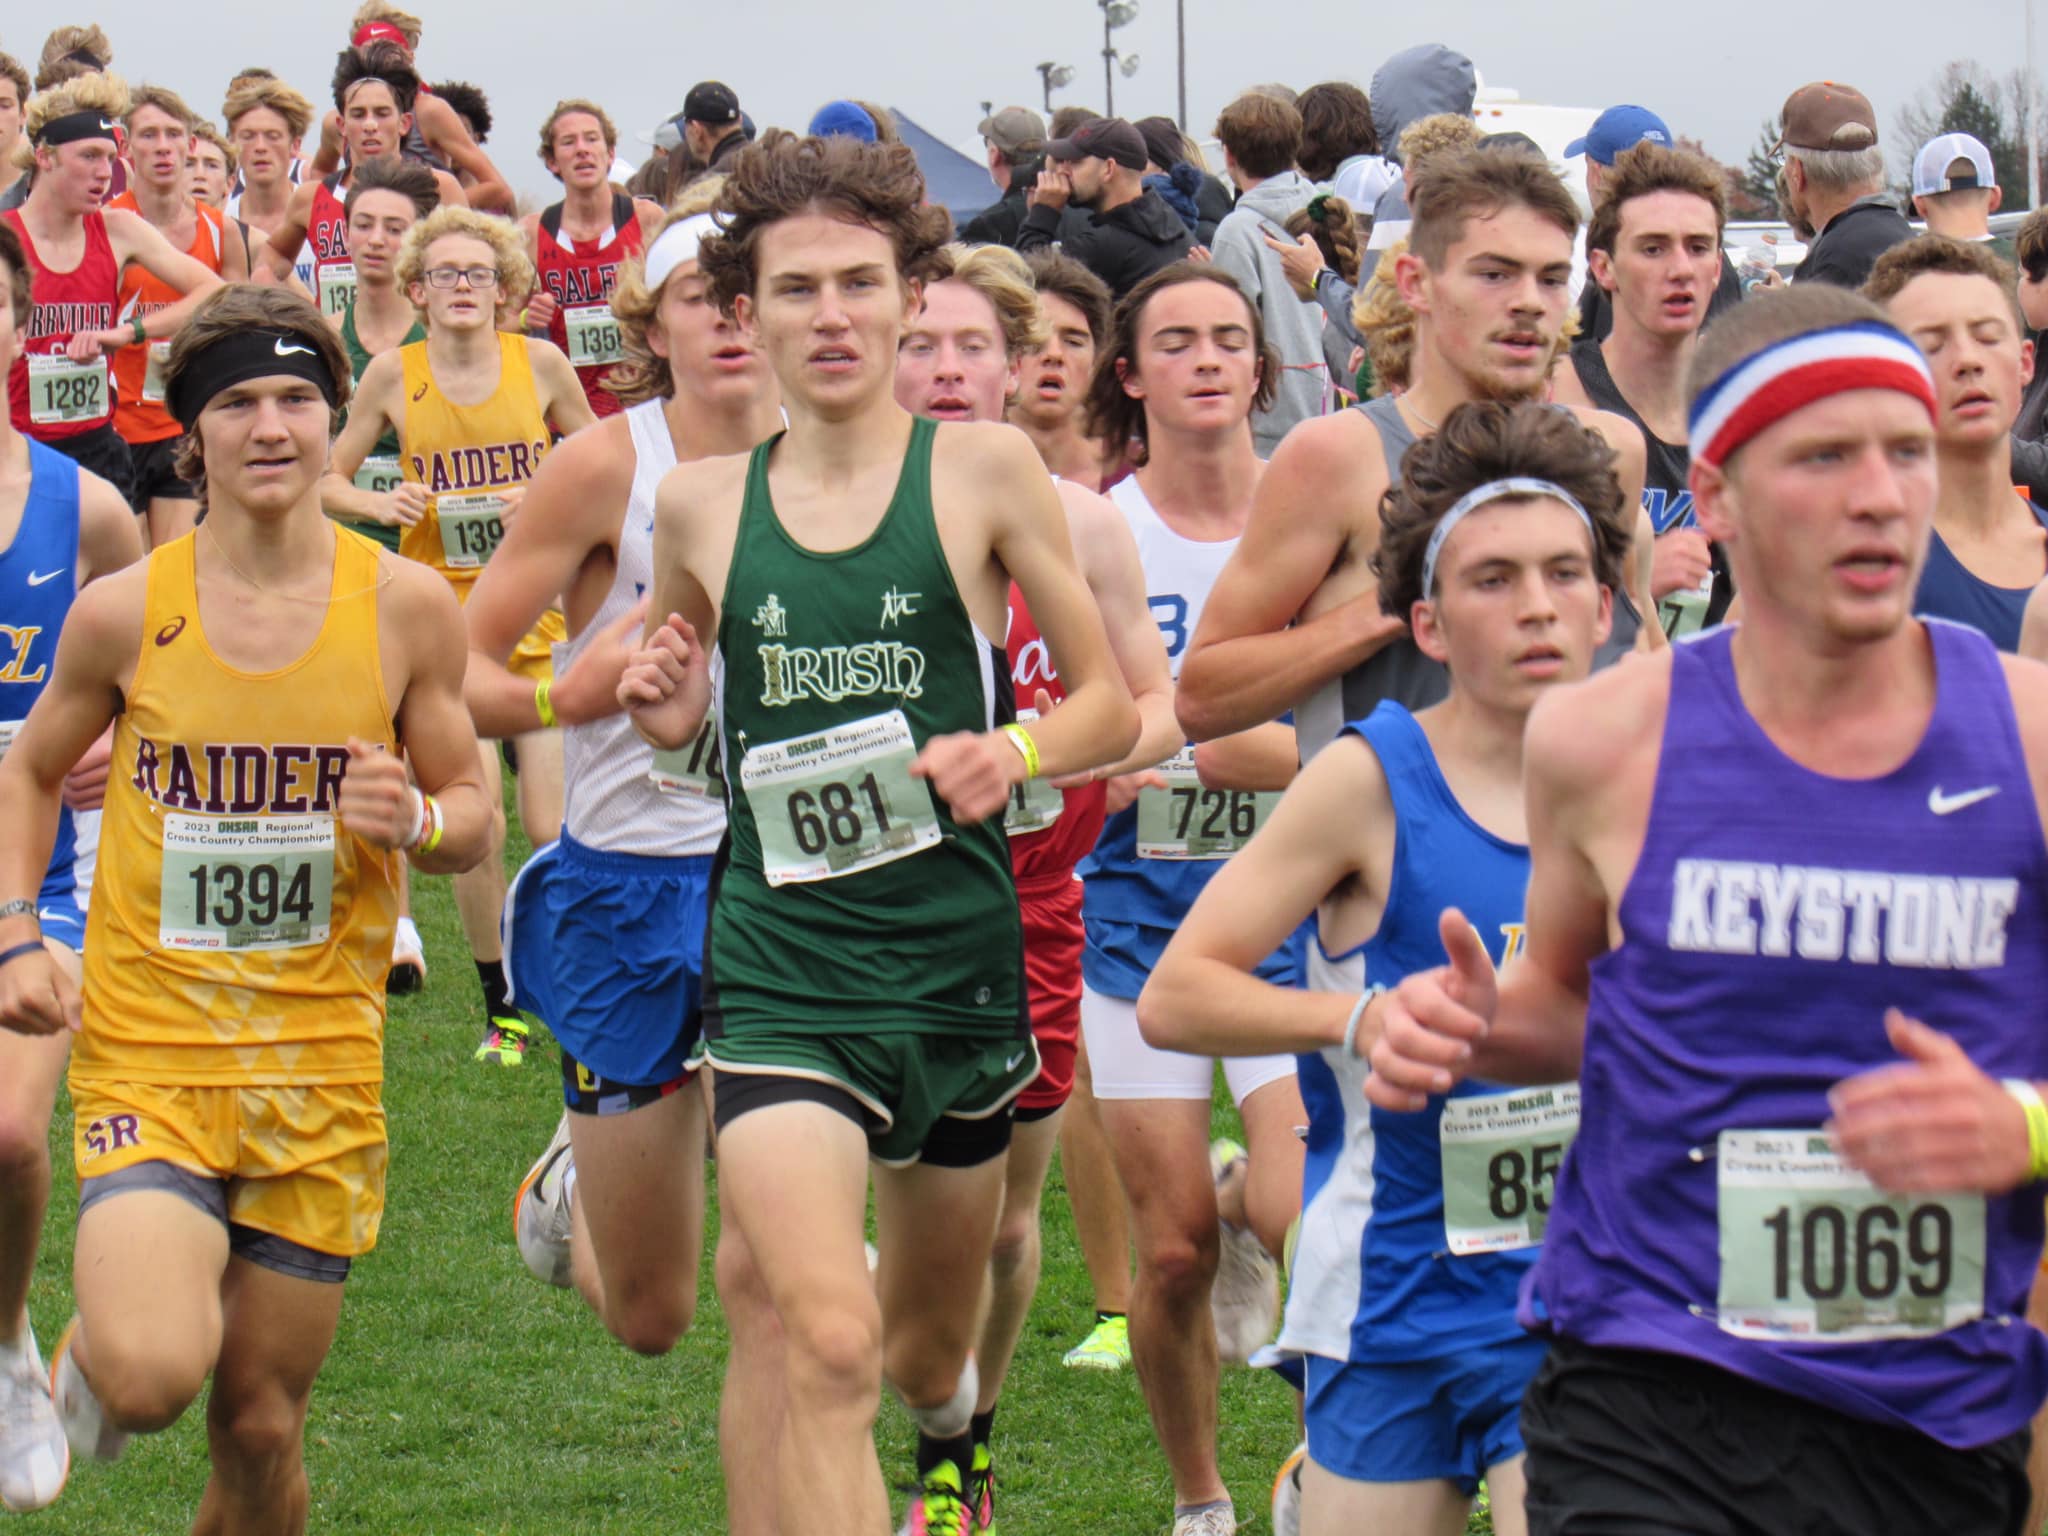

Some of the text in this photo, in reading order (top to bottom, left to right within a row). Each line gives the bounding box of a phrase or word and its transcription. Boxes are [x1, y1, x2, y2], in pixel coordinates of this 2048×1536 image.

[317, 219, 349, 258] SA
[546, 264, 617, 305] SALE
[26, 302, 111, 340] RRVILLE
[578, 324, 623, 355] 135
[44, 375, 100, 411] 1282
[743, 731, 908, 780] Cross Country Championships
[786, 737, 828, 758] OHSAA
[834, 725, 886, 745] Regional
[132, 737, 352, 814] RAIDER
[184, 821, 313, 834] 2023 OHSAA Regional
[787, 772, 891, 855] 681
[1171, 787, 1256, 840] 726
[166, 832, 332, 847] Cross Country Championships
[189, 862, 314, 927] 1394
[1667, 858, 2020, 970] KEYSTONE
[1488, 1143, 1562, 1220] 85
[1763, 1203, 1953, 1302] 1069
